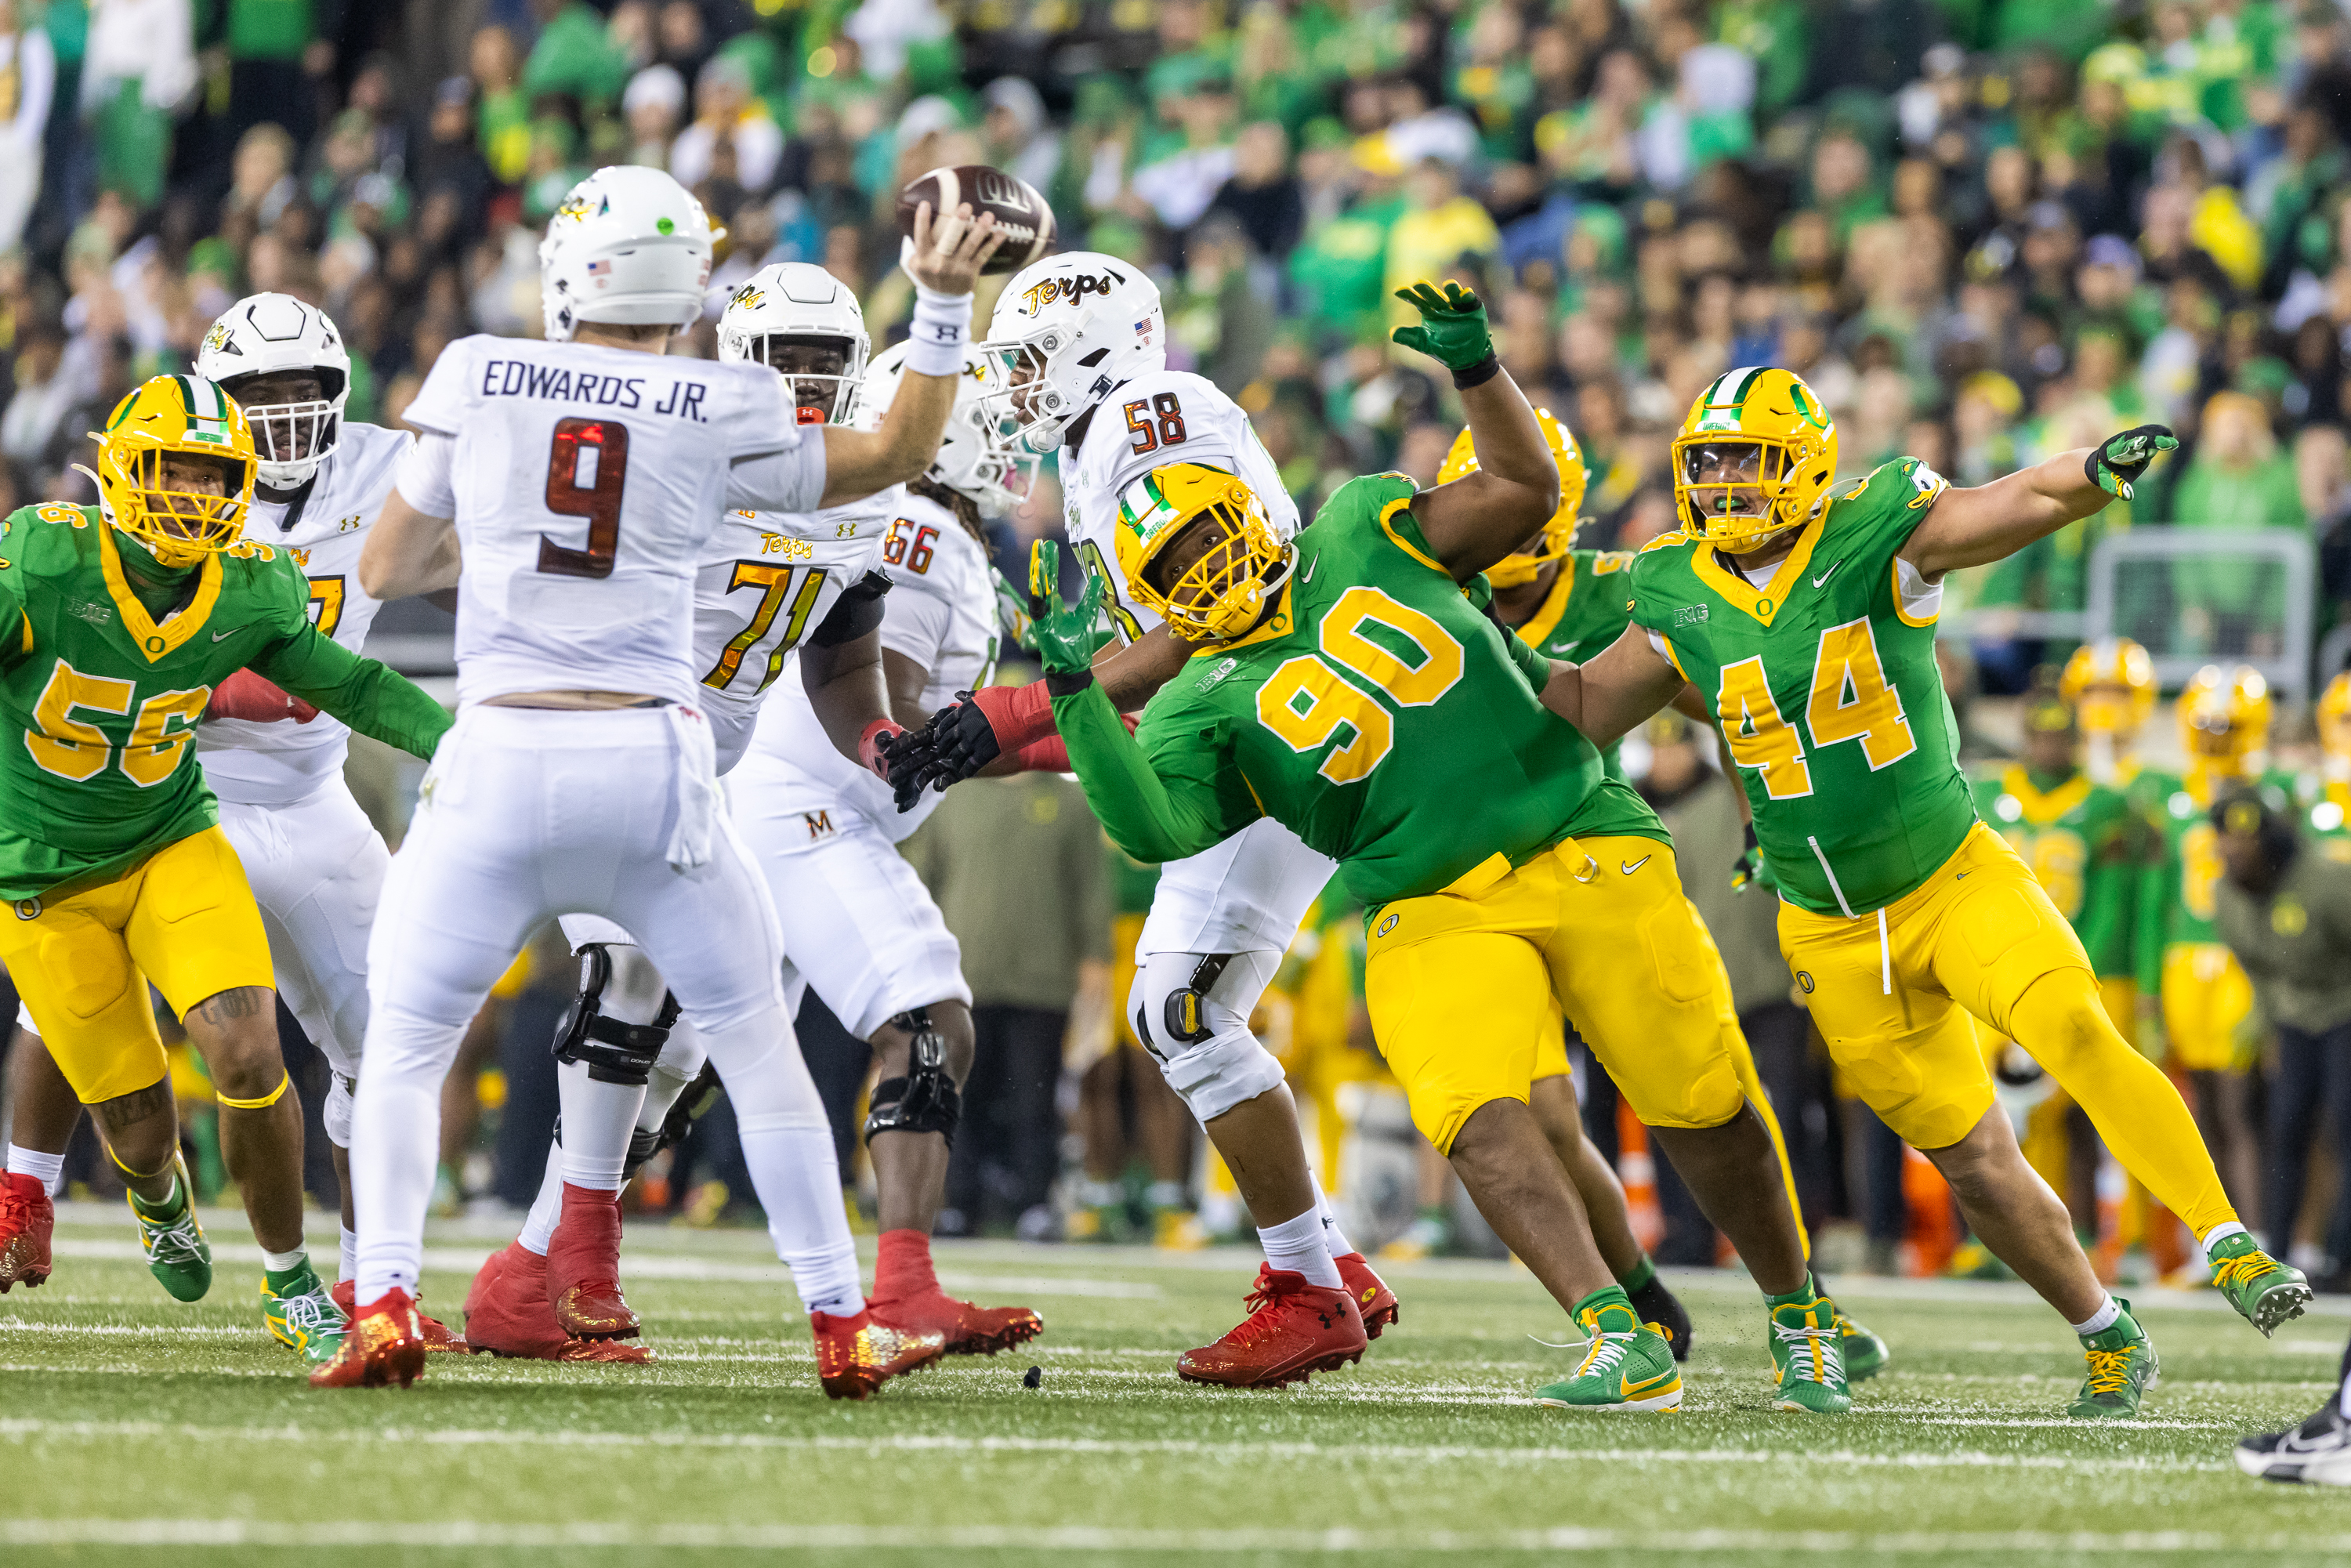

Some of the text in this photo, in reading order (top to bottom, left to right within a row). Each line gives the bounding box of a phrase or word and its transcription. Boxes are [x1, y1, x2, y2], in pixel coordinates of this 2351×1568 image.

[1022, 274, 1110, 315] Terps
[482, 360, 708, 423] EDWARDS JR.
[1123, 392, 1186, 455] 58
[537, 416, 629, 579] 9
[760, 533, 813, 562] Terps
[883, 517, 940, 575] 66
[701, 559, 828, 697] 71
[1255, 585, 1465, 786] 90
[1716, 615, 1918, 800] 44
[24, 657, 212, 788] 56
[805, 810, 835, 838] M
